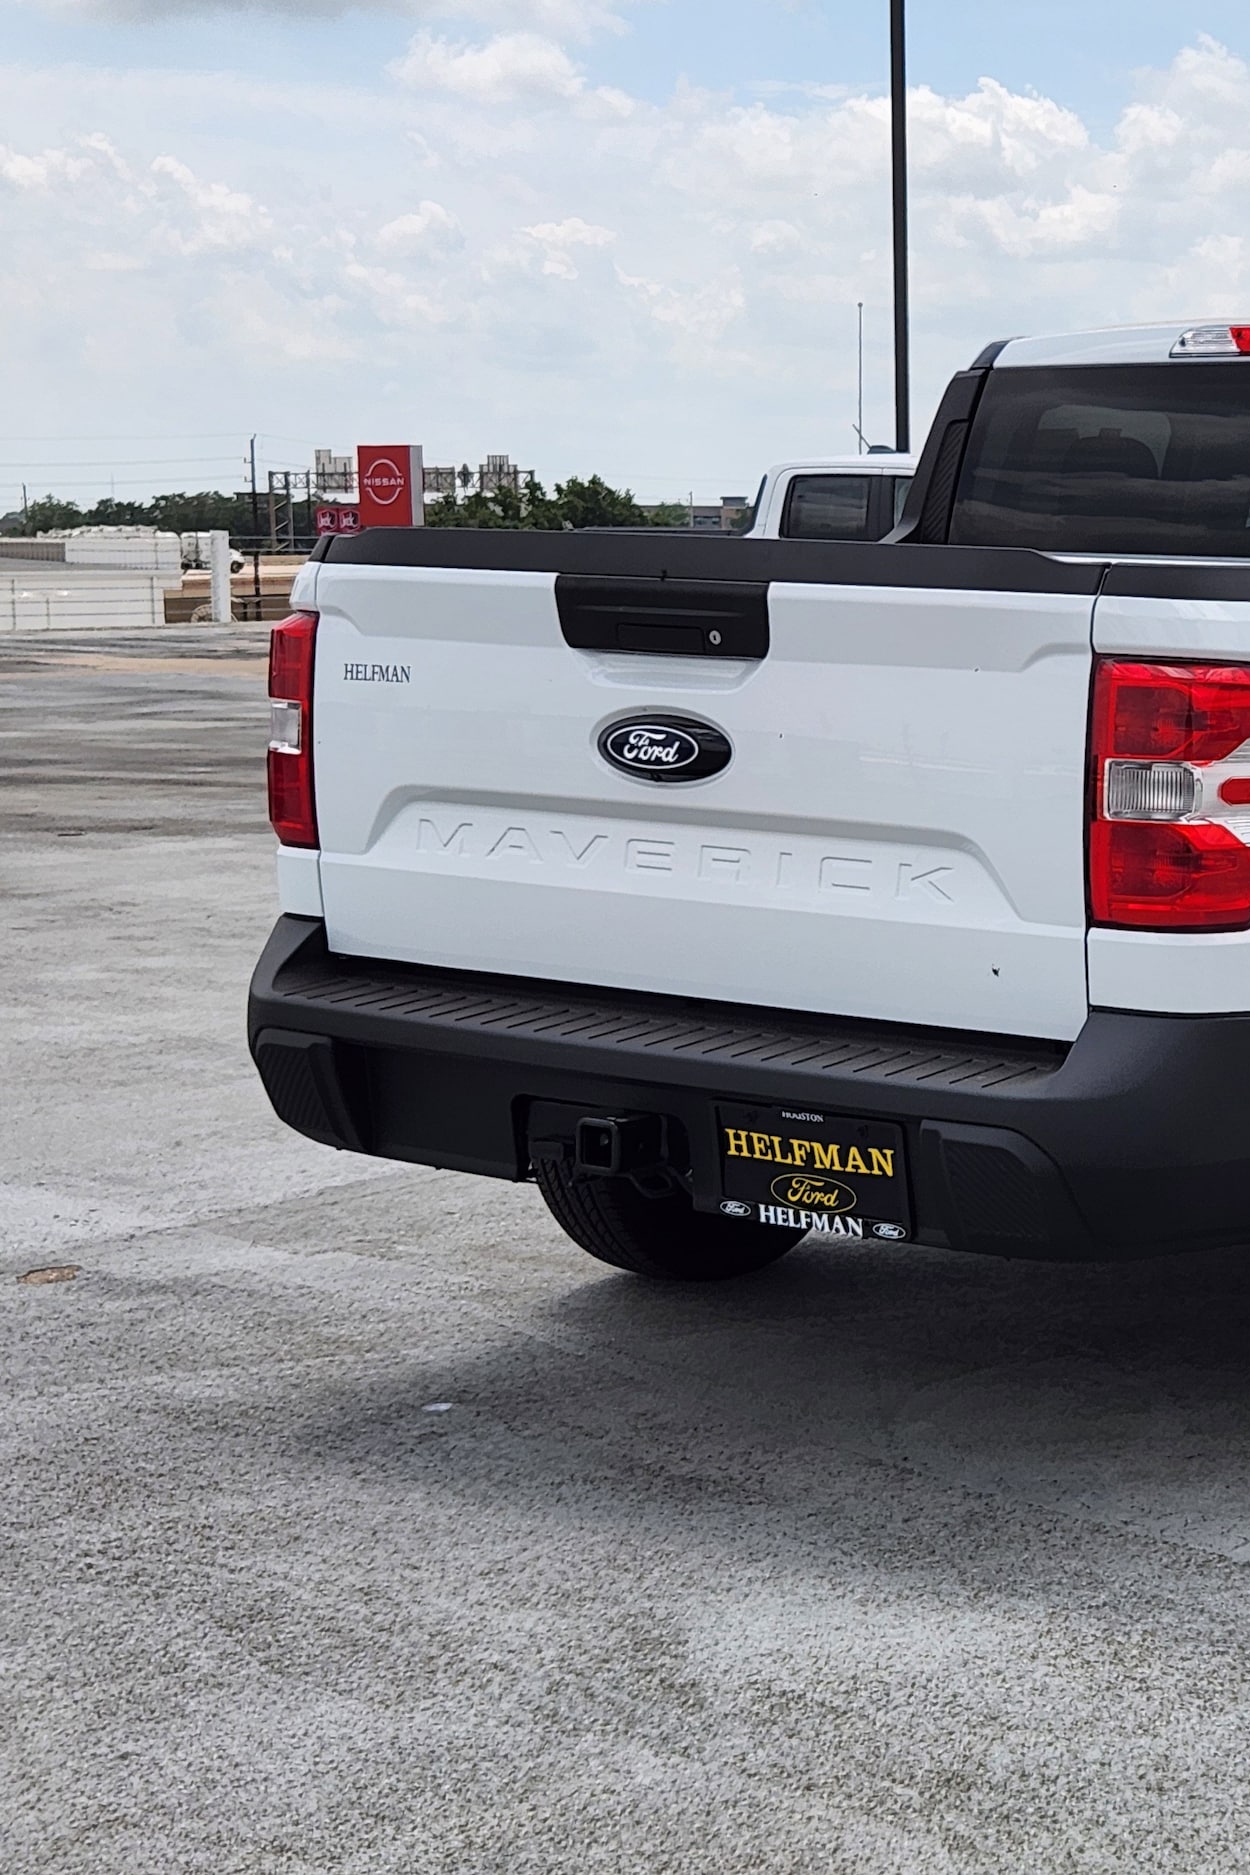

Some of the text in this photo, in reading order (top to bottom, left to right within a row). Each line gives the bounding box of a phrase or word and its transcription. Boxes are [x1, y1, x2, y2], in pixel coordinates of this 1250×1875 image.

[363, 477, 405, 487] NISSAN
[343, 663, 411, 683] HELFMAN
[622, 729, 680, 764] Ford
[414, 818, 957, 903] MAVERICK
[724, 1128, 895, 1177] HELFMAN
[787, 1176, 840, 1208] Ford
[725, 1202, 900, 1238] Ford HELFMAN Ford
